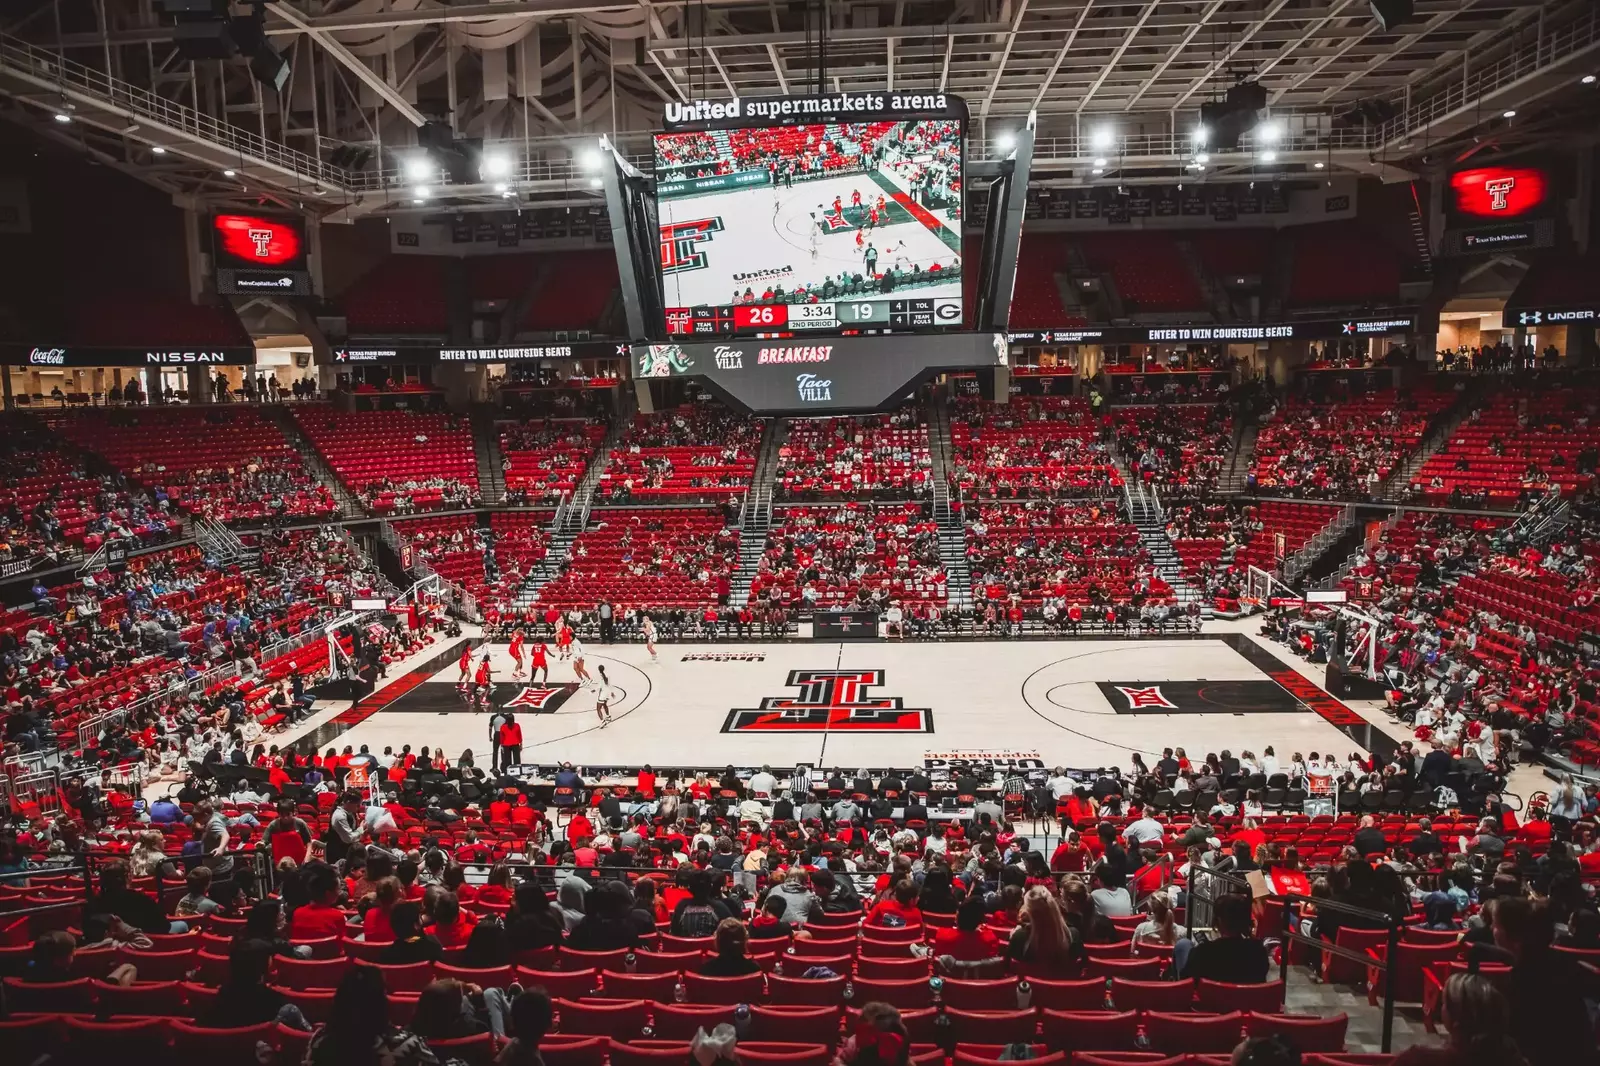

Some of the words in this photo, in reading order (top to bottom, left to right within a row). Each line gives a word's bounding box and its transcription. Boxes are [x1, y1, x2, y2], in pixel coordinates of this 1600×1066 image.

[665, 97, 740, 122] United
[746, 93, 884, 119] supermarkets
[891, 94, 947, 110] arena
[696, 179, 725, 188] NISSAN
[736, 174, 763, 183] NISSAN
[733, 265, 793, 281] United
[723, 308, 729, 317] 4
[749, 307, 774, 324] 26
[802, 305, 832, 317] 3:34
[851, 303, 873, 320] 19
[895, 302, 902, 310] 4
[1547, 311, 1594, 320] UNDER
[723, 322, 729, 330] 4
[792, 320, 805, 328] 2ND
[896, 315, 902, 324] 4
[1149, 329, 1177, 340] ENTER
[1179, 329, 1190, 339] TO
[1192, 328, 1212, 339] WIN
[1213, 328, 1264, 338] COURTSIDE
[1265, 326, 1293, 337] SEATS
[147, 352, 224, 363] NISSAN
[440, 350, 465, 360] ENTER
[466, 350, 477, 359] TO
[479, 349, 497, 359] WIN
[498, 348, 544, 358] COURTSIDE
[545, 346, 571, 357] SEATS
[713, 346, 743, 359] Taco
[757, 346, 833, 364] BREAKFAST
[716, 358, 743, 369] VILLA
[796, 373, 832, 388] Taco
[798, 388, 831, 401] VILLA
[1, 559, 32, 577] HOUSE
